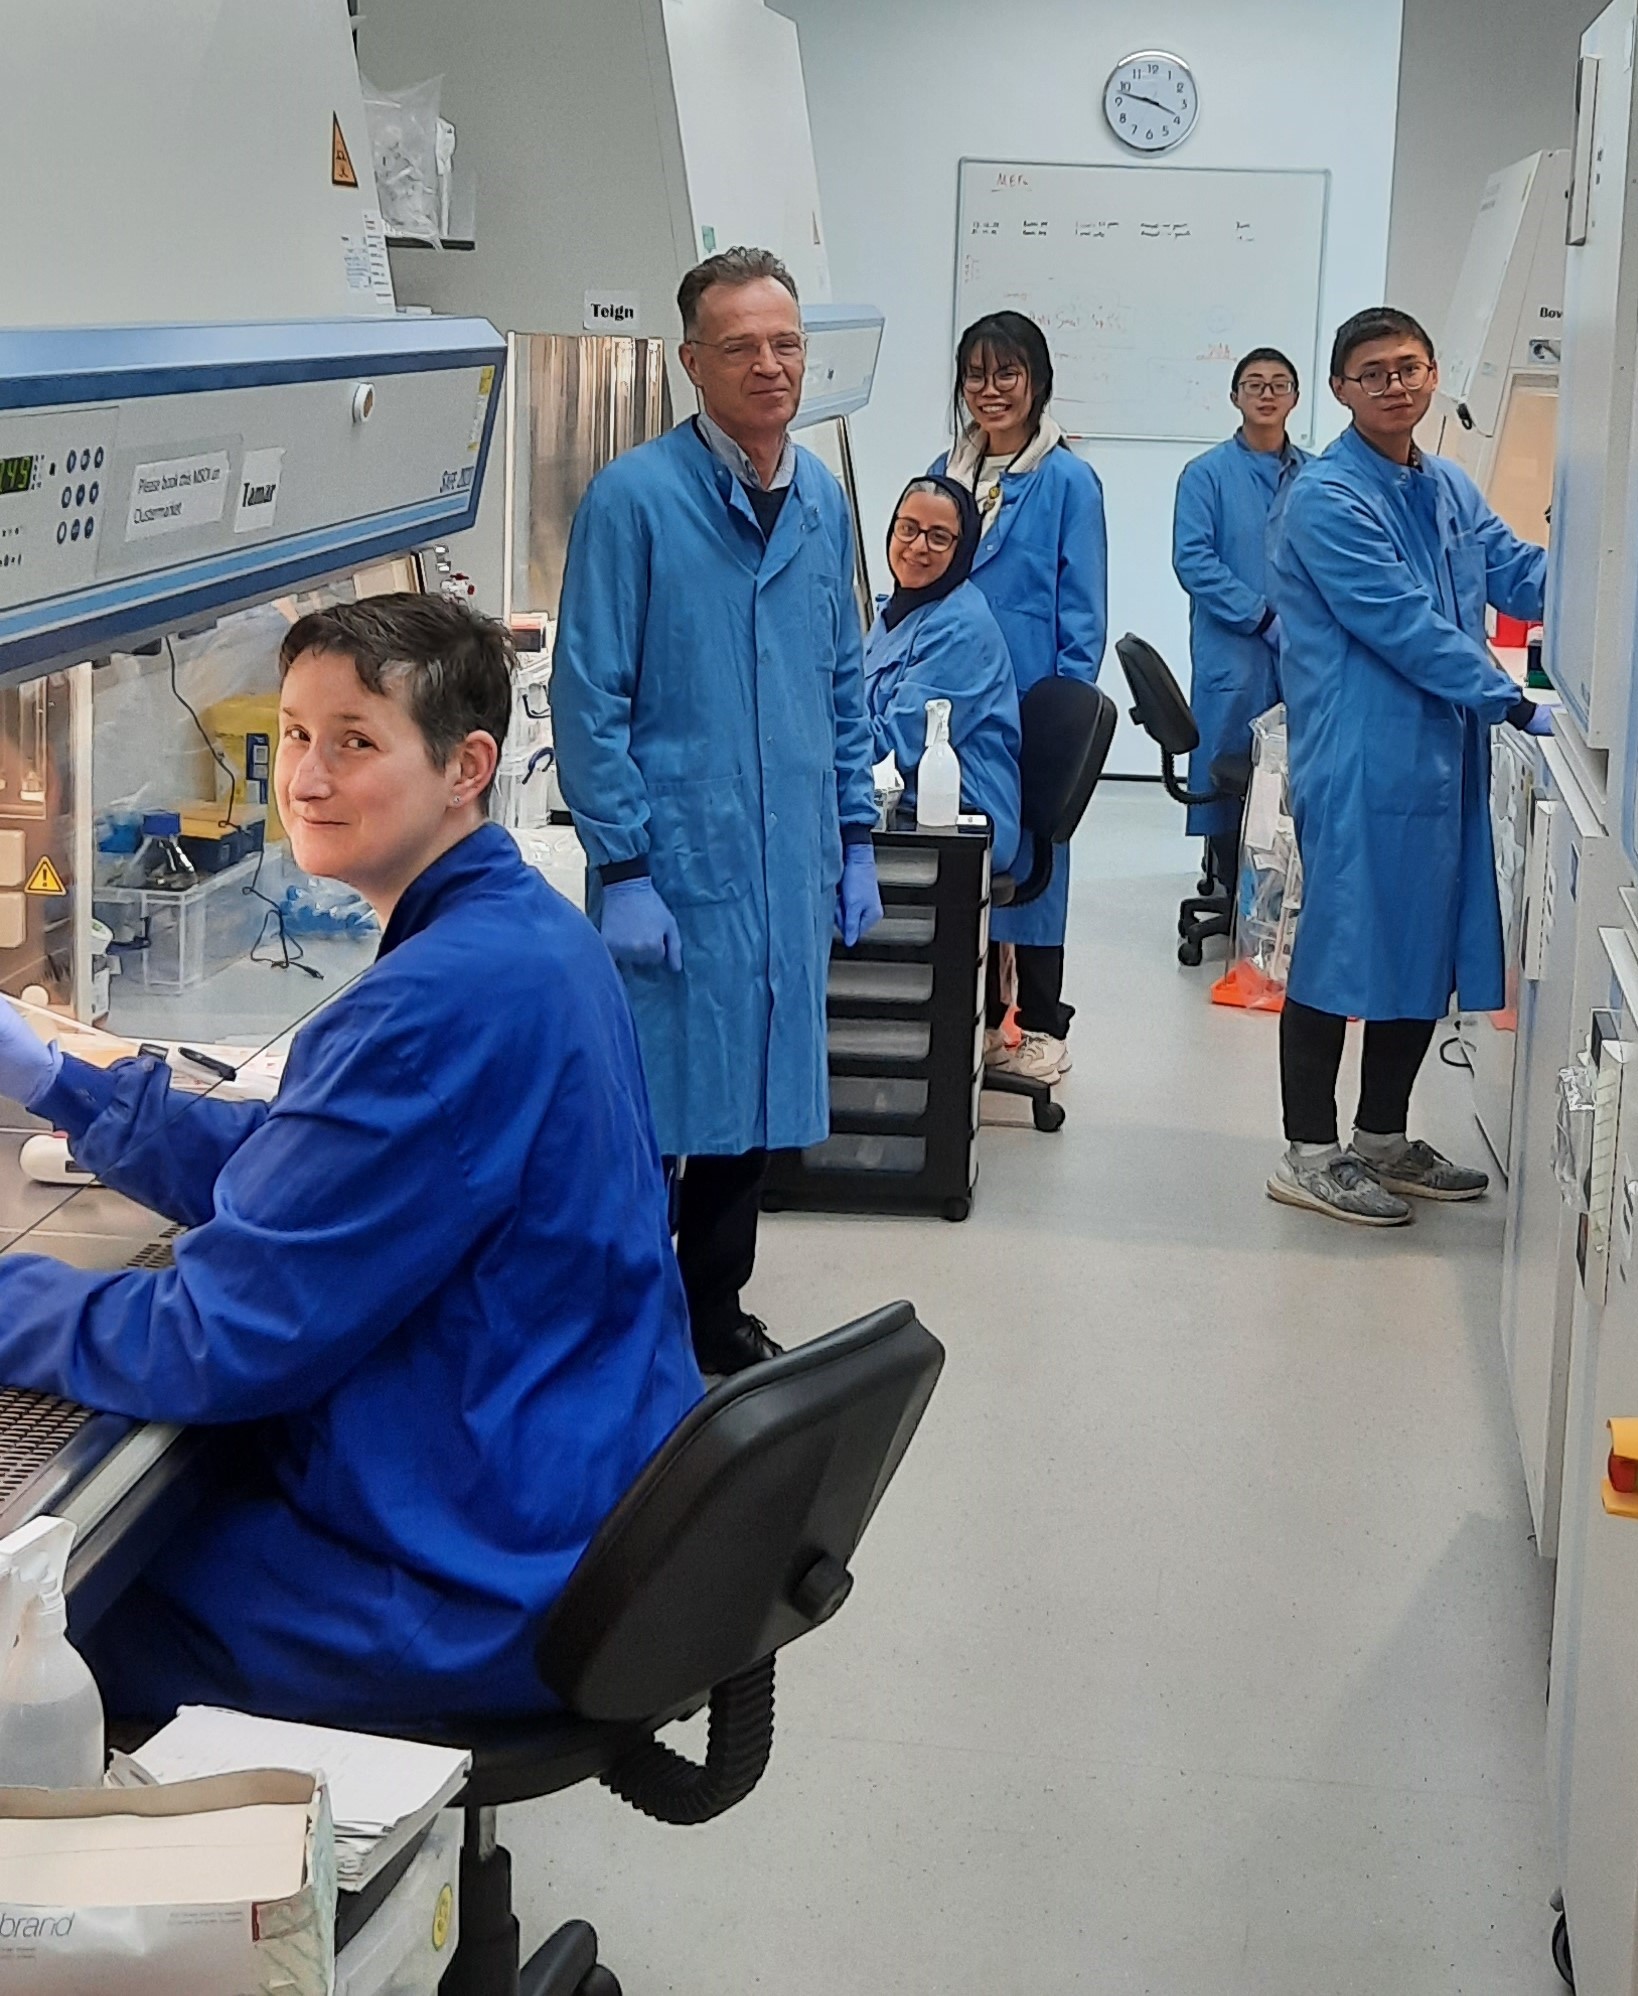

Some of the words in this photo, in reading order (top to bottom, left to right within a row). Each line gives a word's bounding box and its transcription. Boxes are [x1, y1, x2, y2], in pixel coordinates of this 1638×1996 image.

[1132, 69, 1142, 79] 11
[1147, 64, 1159, 74] 12
[1119, 81, 1131, 92] 10
[1176, 82, 1184, 93] 2
[1114, 96, 1123, 107] 9
[1181, 98, 1188, 110] 3
[1119, 112, 1127, 124] 8
[1173, 116, 1181, 125] 4
[1131, 124, 1138, 135] 7
[1145, 128, 1154, 140] 6
[1162, 125, 1169, 137] 5
[590, 303, 634, 321] Teign
[0, 1911, 75, 1937] brand
